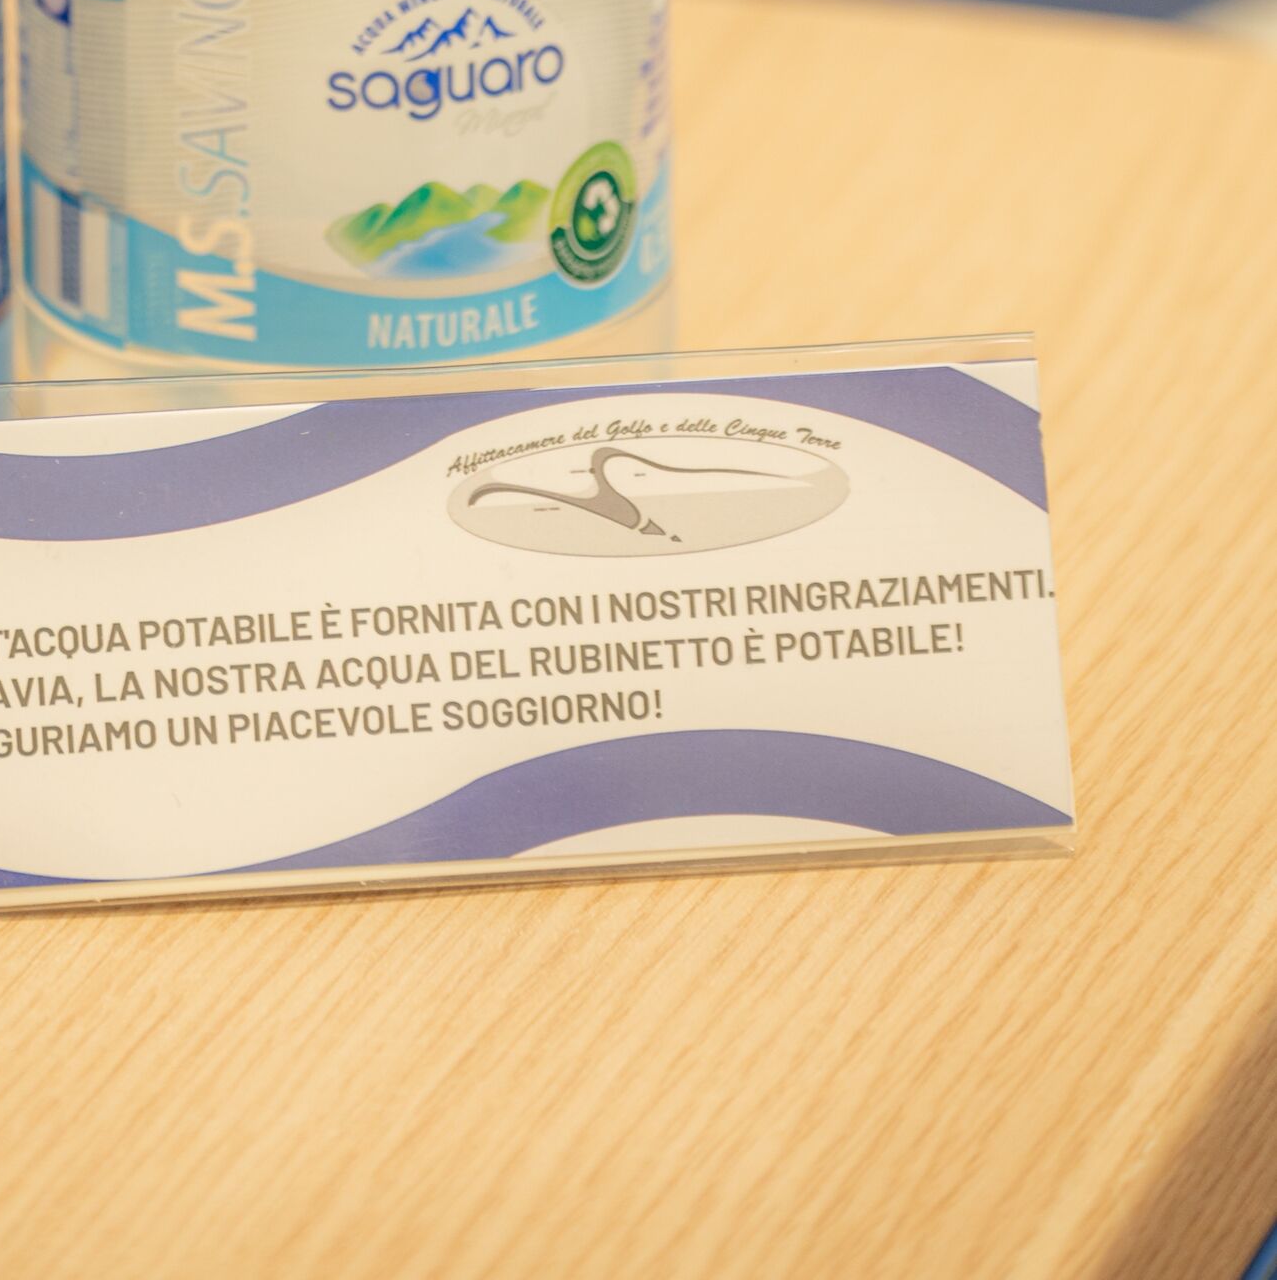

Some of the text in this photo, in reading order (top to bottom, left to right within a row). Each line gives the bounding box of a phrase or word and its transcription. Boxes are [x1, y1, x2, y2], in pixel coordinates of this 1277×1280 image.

[351, 10, 396, 55] ACQUA
[327, 44, 564, 121] saguaro
[367, 293, 540, 349] NATURALE
[446, 418, 842, 477] Affittacamere del Golfo e delle Cinque Terre
[138, 610, 313, 651] POTABILE
[320, 602, 343, 640] È
[350, 600, 504, 638] FORNITA
[510, 595, 584, 629] CON
[591, 594, 601, 625] I
[608, 586, 737, 624] NOSTRI
[745, 568, 1056, 616] RINGRAZIAMENTI.
[94, 670, 146, 703] LA
[154, 660, 307, 700] NOSTRA
[315, 652, 442, 690] ACQUA
[449, 648, 521, 682] DEL
[529, 636, 734, 677] RUBINETTO
[743, 626, 767, 665] È
[774, 622, 965, 663] POTABILE!
[166, 714, 219, 748] UN
[227, 702, 433, 744] PIACEVOLE
[442, 689, 663, 731] SOGGIORNO!
